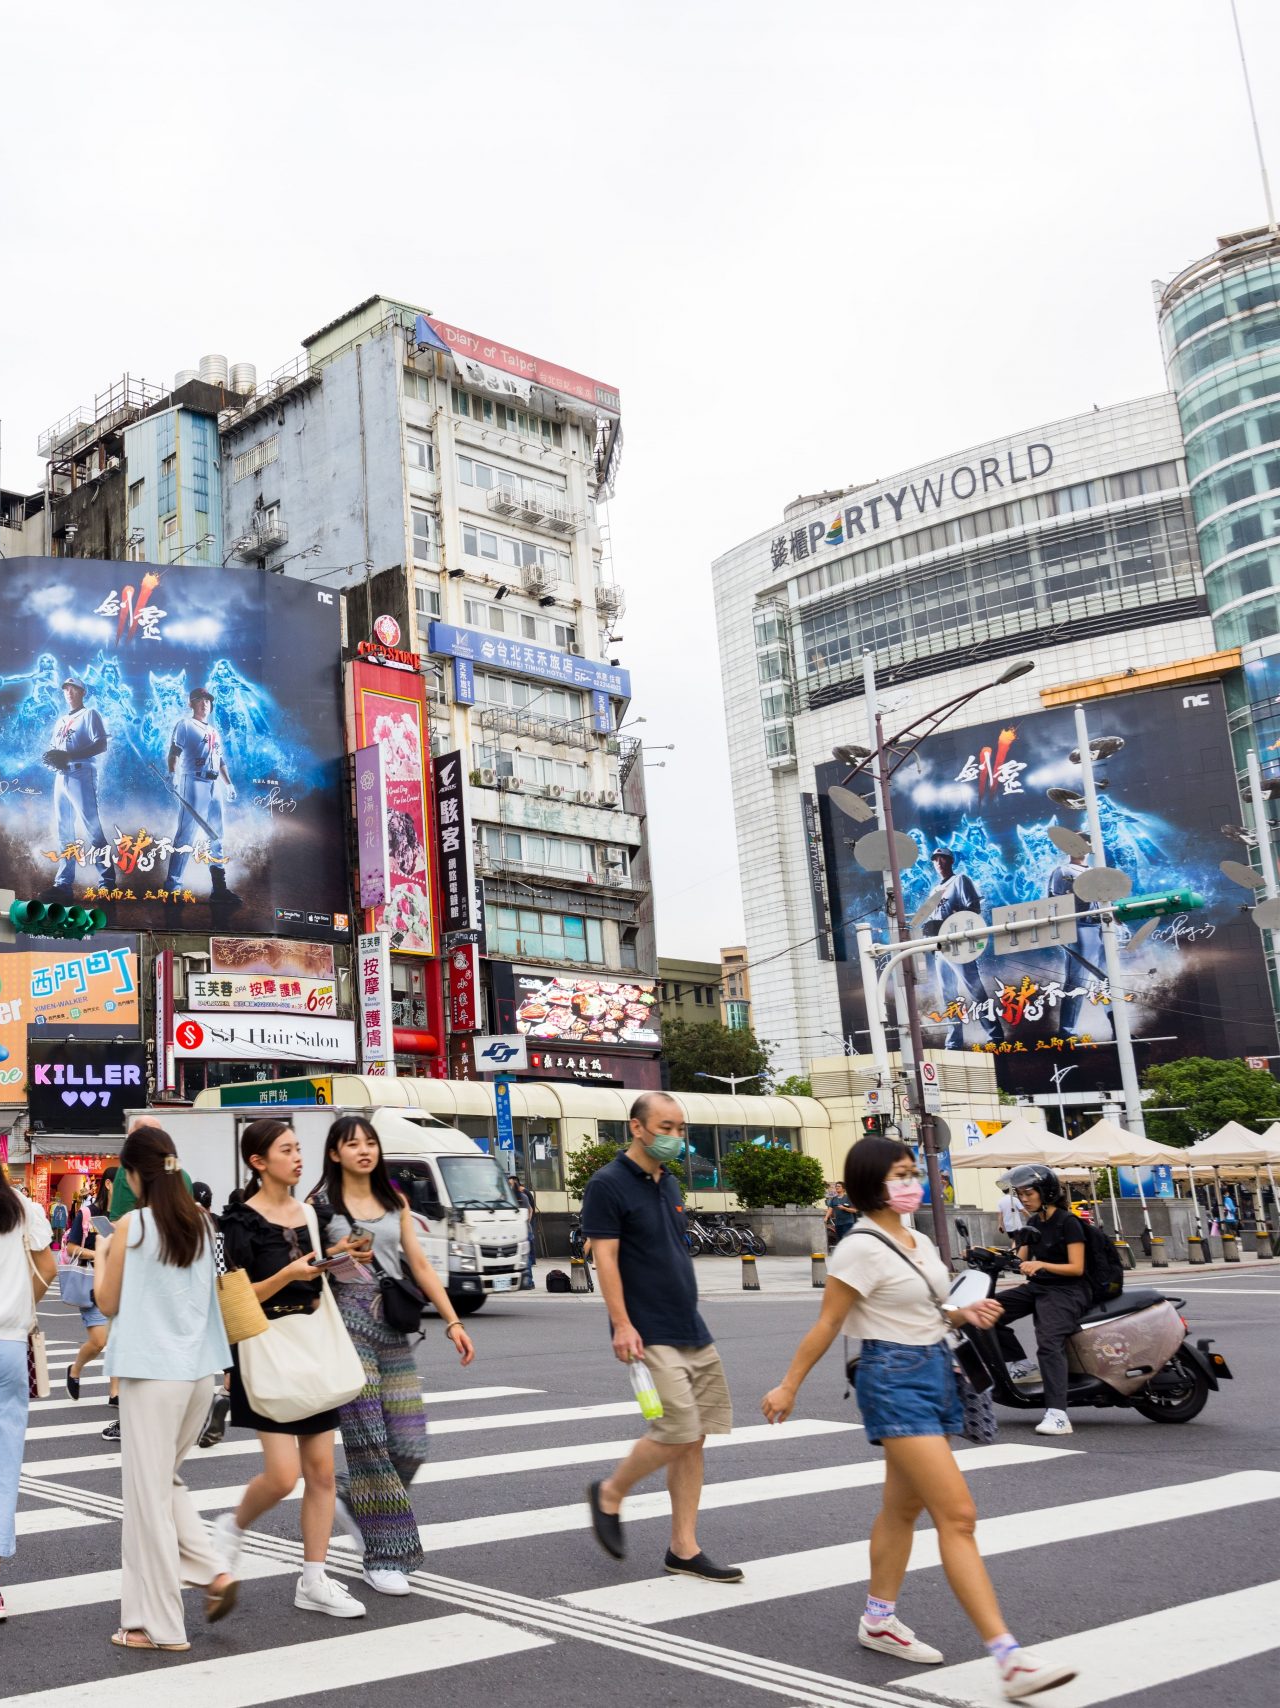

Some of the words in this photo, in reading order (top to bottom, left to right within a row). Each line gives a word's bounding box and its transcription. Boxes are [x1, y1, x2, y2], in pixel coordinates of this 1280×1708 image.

[445, 328, 479, 352] Diary
[483, 347, 497, 359] of
[500, 350, 538, 374] Taipei
[386, 648, 421, 671] STONE
[497, 641, 574, 674] 台北天禾旅店
[502, 658, 524, 668] TAIPEI
[546, 668, 568, 680] HOTEL
[42, 824, 230, 875] 我們就不一樣
[143, 888, 196, 904] 立即下載
[31, 947, 135, 998] 西門町
[363, 957, 380, 996] 按摩
[194, 980, 233, 997] 玉芙蓉
[234, 986, 247, 994] SPA
[249, 979, 277, 997] 按摩
[34, 996, 89, 1013] XIMEN-WALKER
[249, 1028, 293, 1045] Hair
[295, 1029, 339, 1048] Salon
[365, 1010, 381, 1048] 護膚
[34, 1063, 141, 1086] KILLER
[259, 1089, 288, 1104] 西門站
[315, 1086, 326, 1105] 6
[67, 1158, 102, 1170] KILLER
